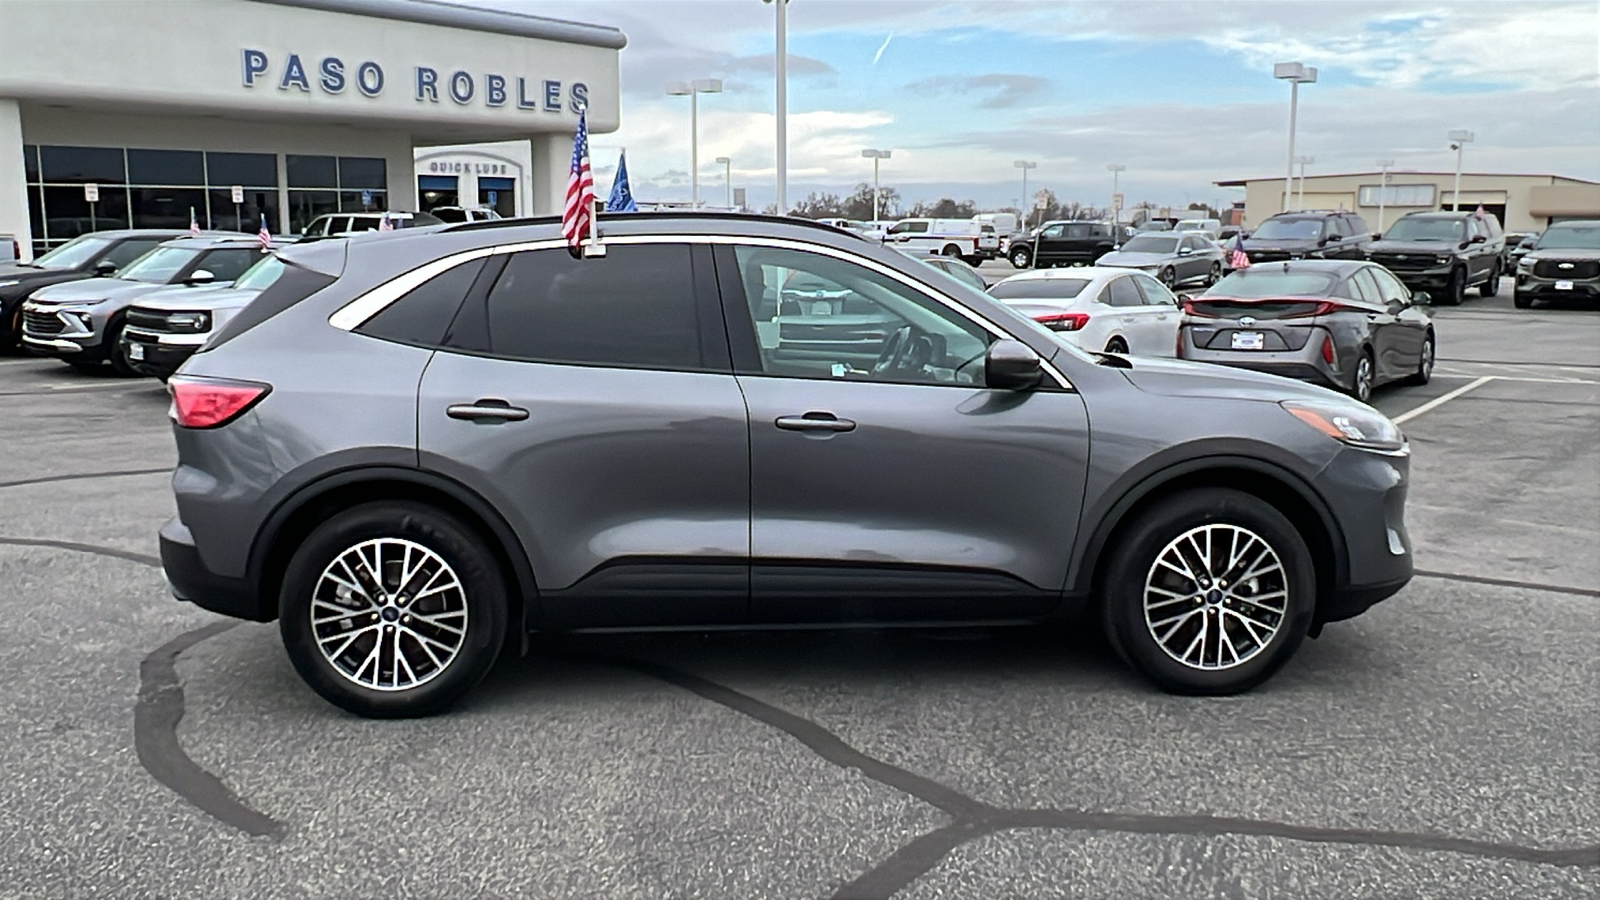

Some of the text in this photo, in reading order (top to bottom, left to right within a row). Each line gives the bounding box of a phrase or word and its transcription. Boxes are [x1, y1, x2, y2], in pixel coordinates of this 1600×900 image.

[242, 48, 590, 114] PASO ROBLES
[430, 162, 471, 174] QUICK
